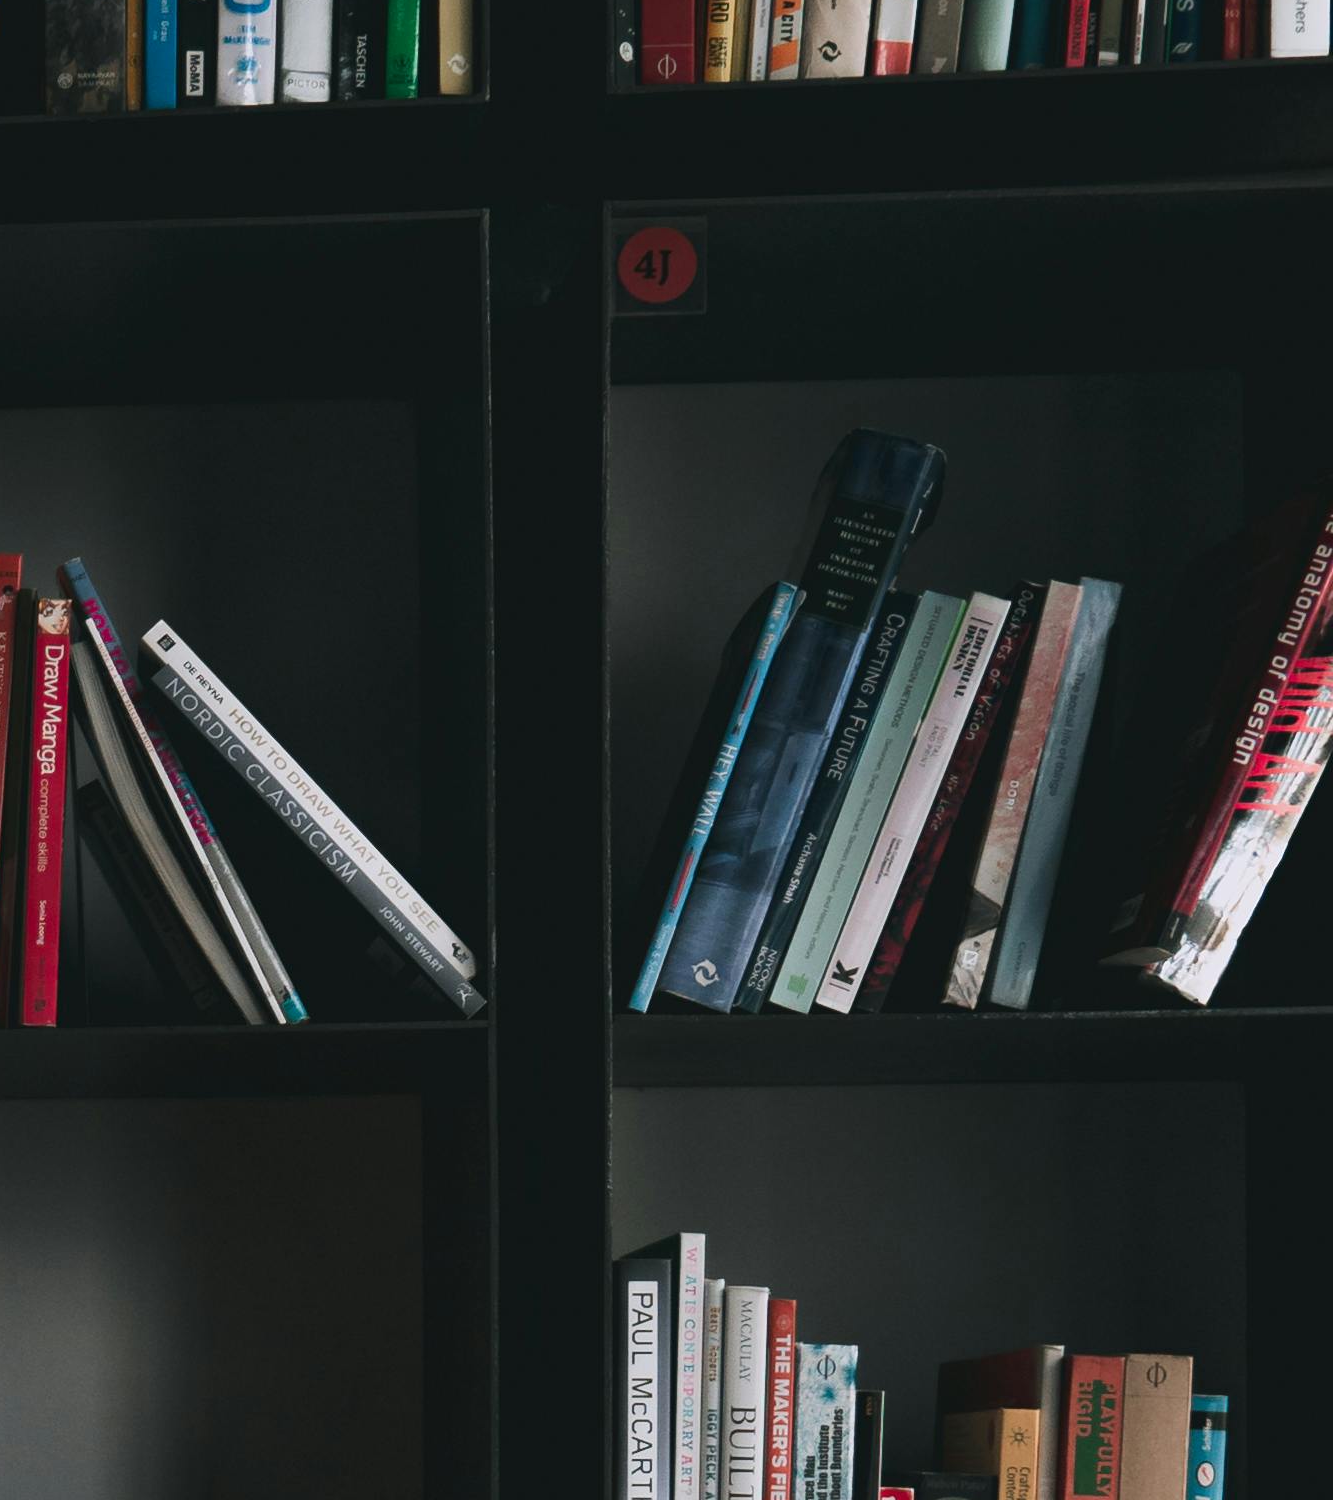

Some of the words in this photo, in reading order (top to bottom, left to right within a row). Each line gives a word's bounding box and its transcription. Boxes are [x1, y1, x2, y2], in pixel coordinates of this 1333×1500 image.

[188, 53, 202, 95] MoMA
[1277, 544, 1333, 646] anatomy
[44, 645, 65, 699] Draw
[1268, 656, 1288, 680] of
[36, 702, 64, 775] Manga
[1232, 688, 1277, 765] design
[164, 679, 251, 761] NORDIC
[244, 763, 360, 883] CLASSICISM
[631, 1292, 653, 1365] PAUL
